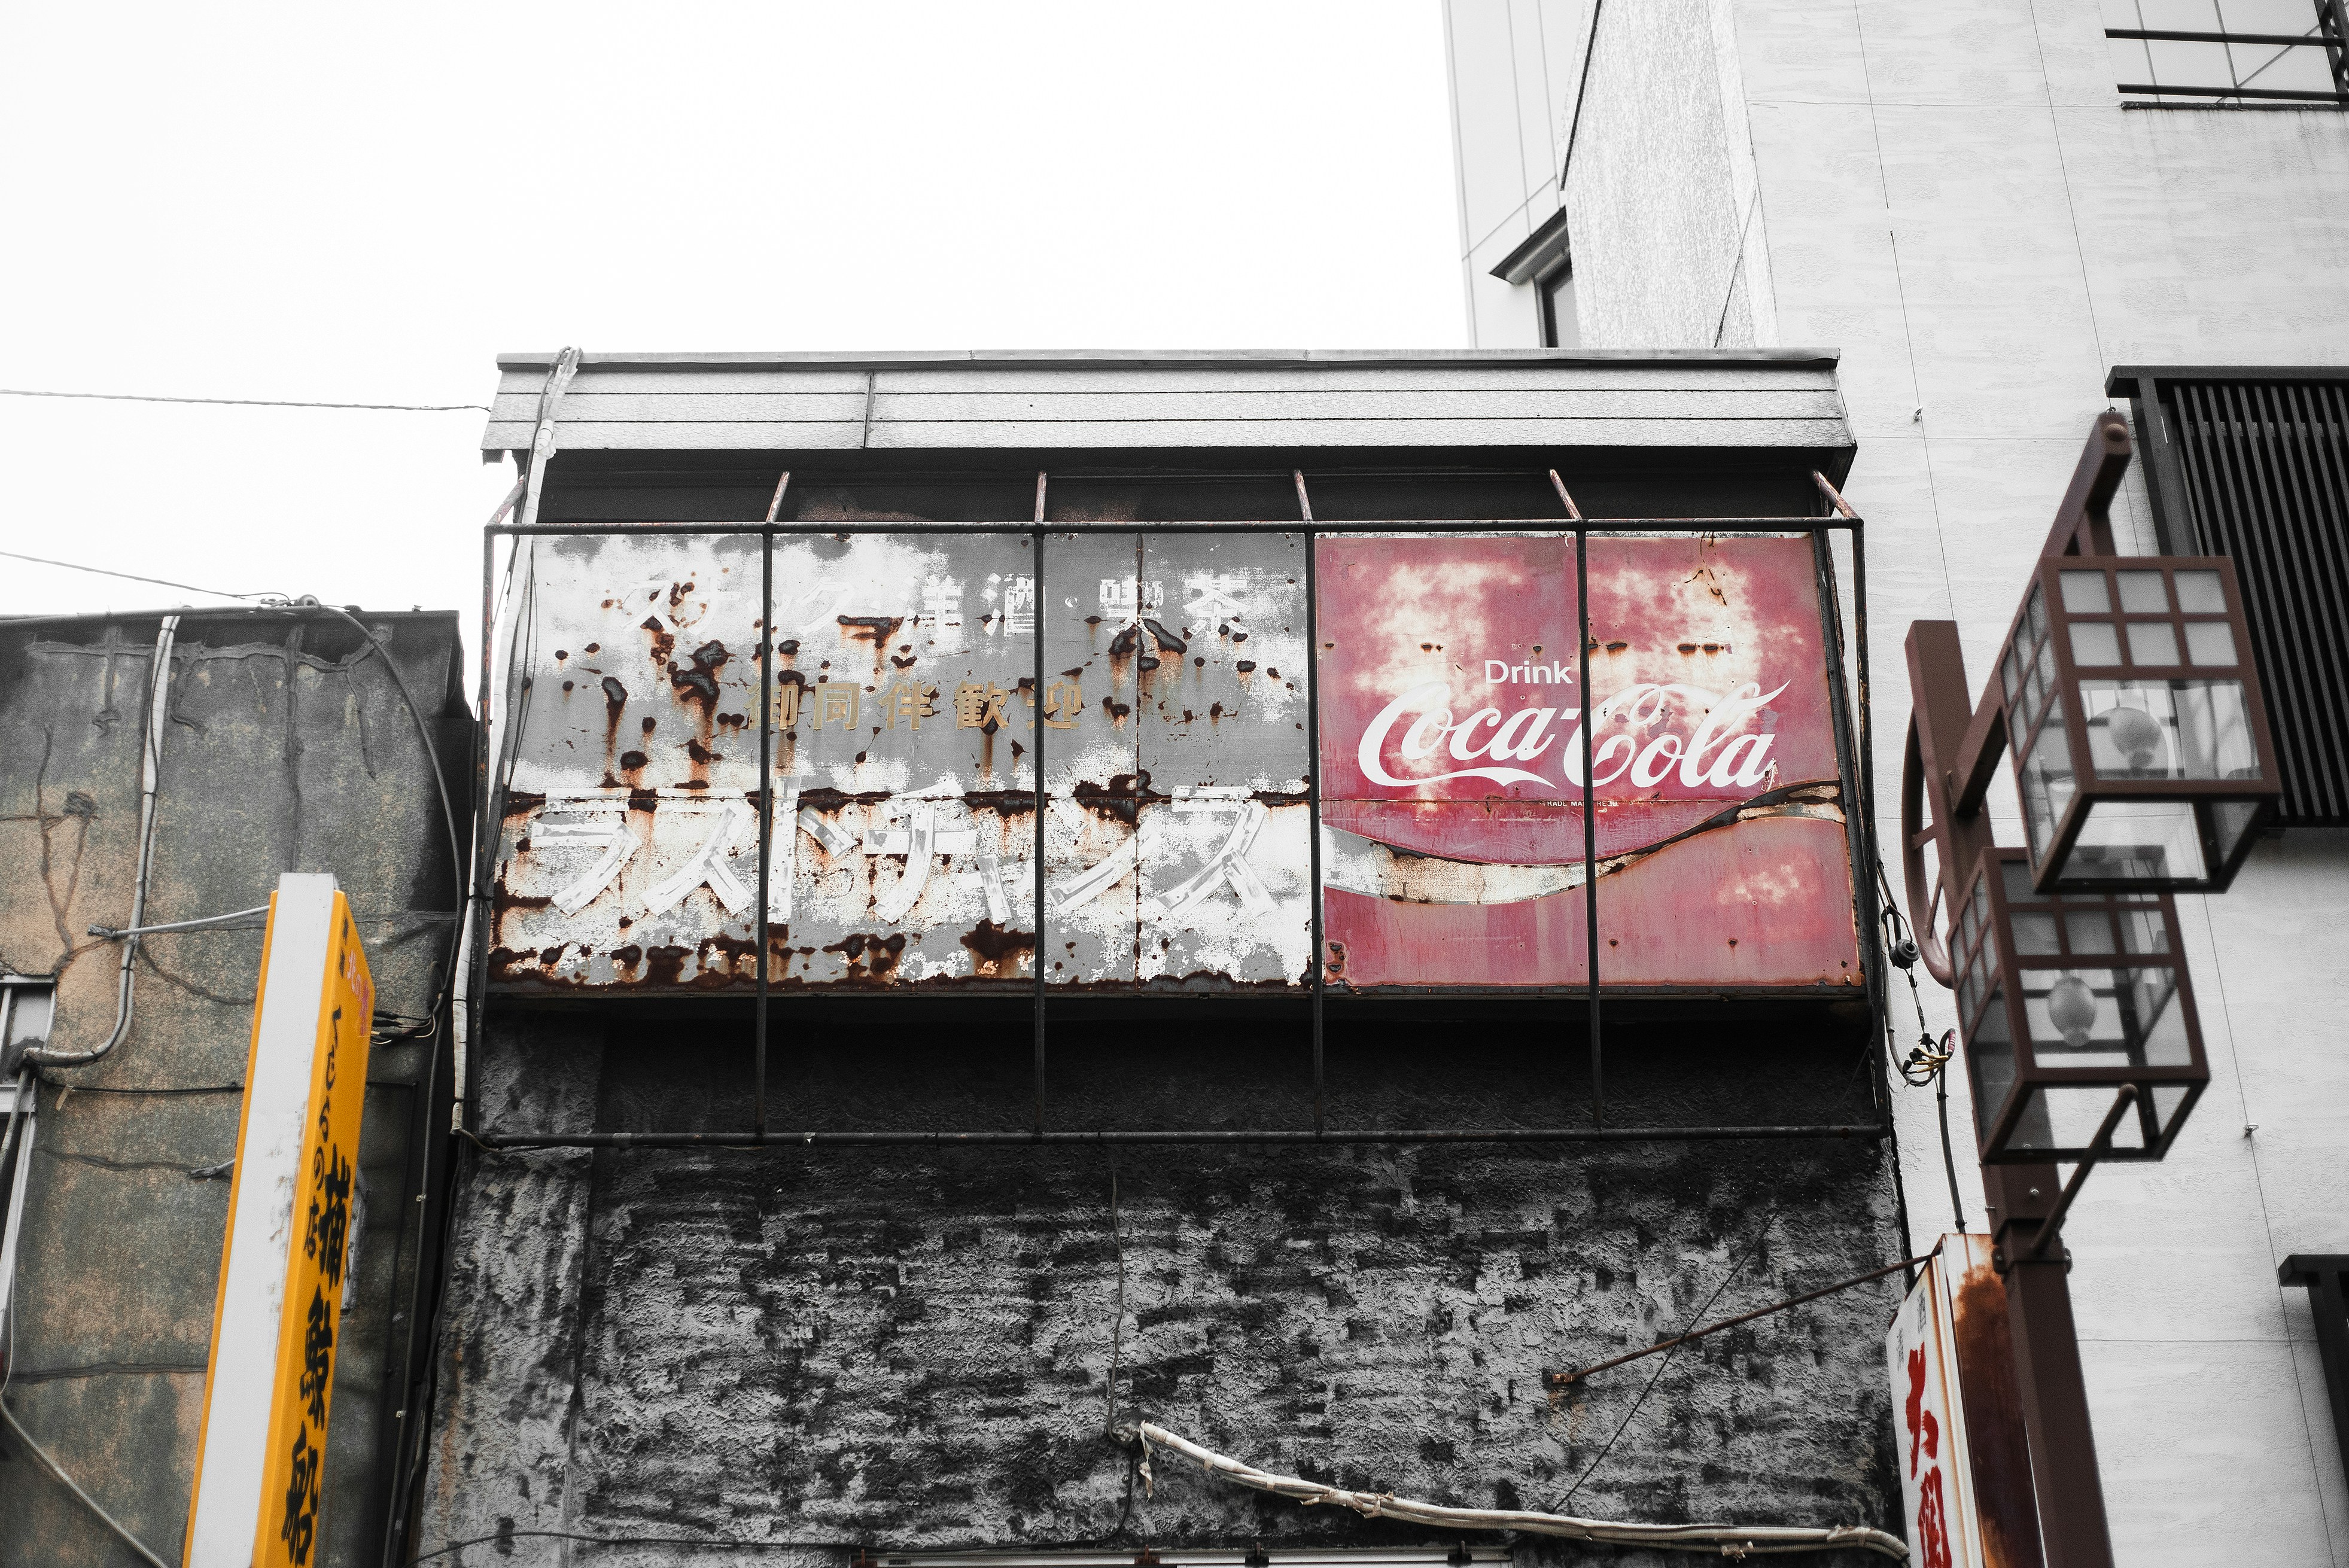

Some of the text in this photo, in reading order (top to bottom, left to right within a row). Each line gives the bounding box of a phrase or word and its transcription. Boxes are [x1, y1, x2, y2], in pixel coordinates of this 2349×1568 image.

[743, 680, 1083, 731] 御同伴歓迎
[1358, 679, 1791, 790] Coca-Cola
[1485, 659, 1572, 684] Drink
[530, 776, 1276, 924] ラストチャンス
[303, 1005, 342, 1260] くじらの店
[281, 1143, 351, 1567] 捕鯨船
